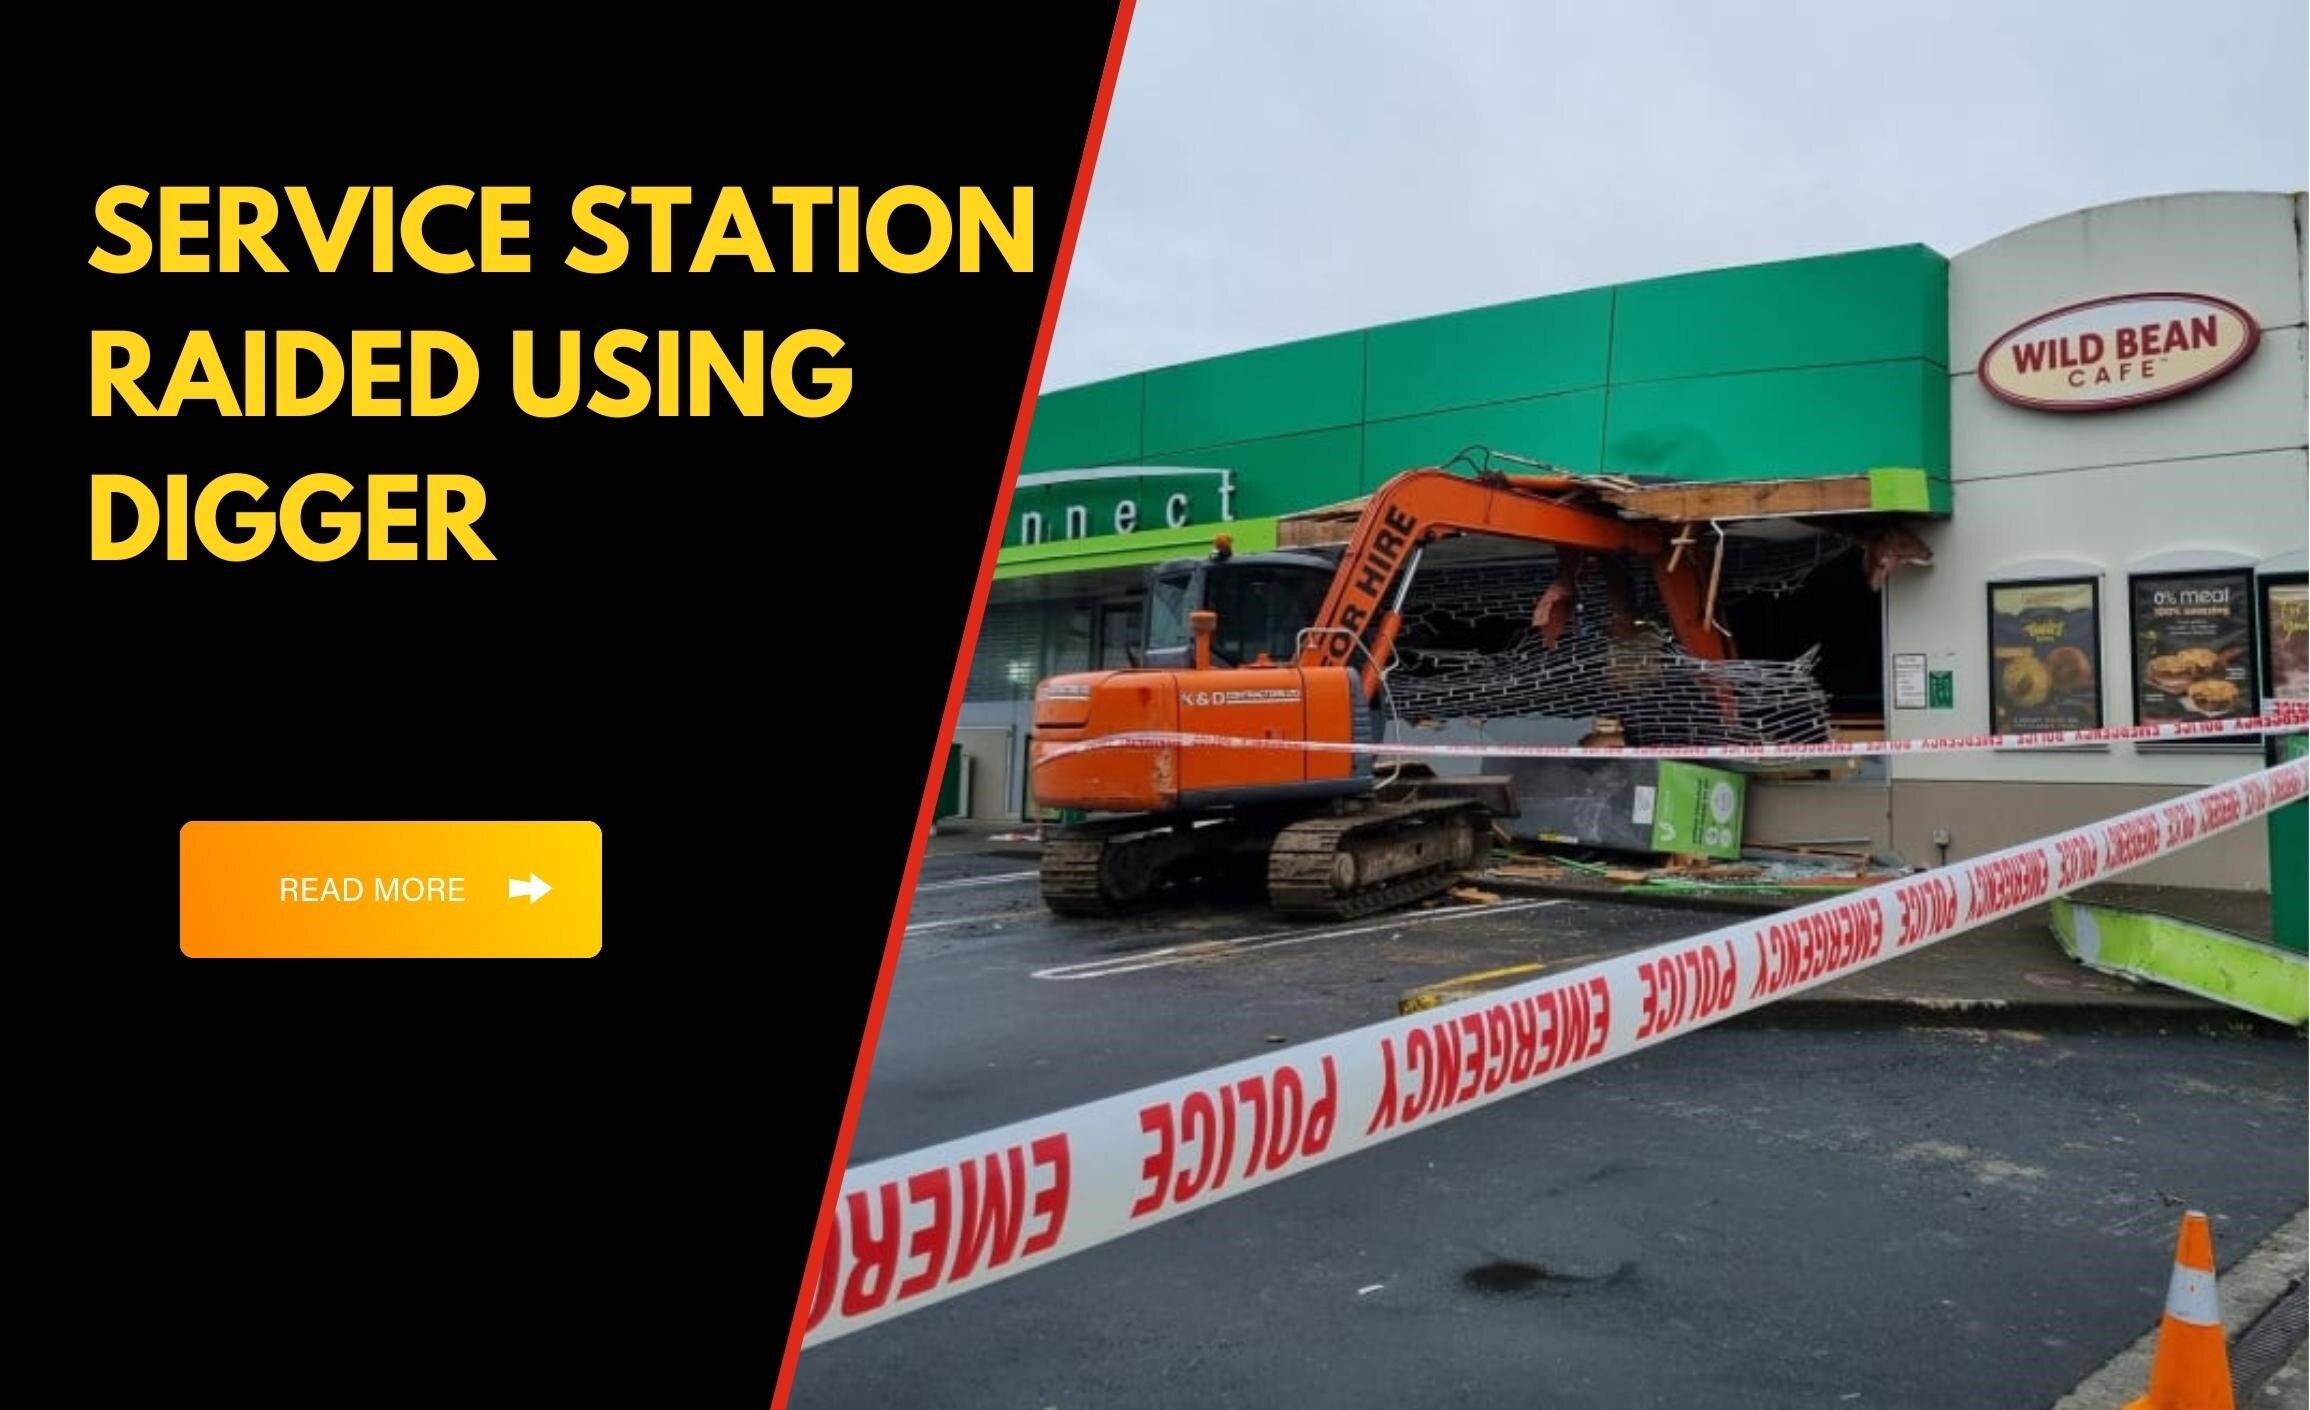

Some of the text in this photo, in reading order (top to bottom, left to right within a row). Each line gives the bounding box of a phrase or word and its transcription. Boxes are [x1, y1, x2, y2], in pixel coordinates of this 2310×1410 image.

[2012, 314, 2218, 373] WILD BEAN
[2068, 361, 2155, 387] CAFE
[1354, 504, 1418, 598] HIRE
[1181, 692, 1195, 706] K
[1196, 692, 1210, 706] &
[2055, 834, 2099, 890] POLICE
[2104, 813, 2161, 871] EMERGENCY
[1895, 875, 1959, 948] POLICE
[1966, 847, 2050, 922] EMERGENCY
[1752, 896, 1885, 1000] EMERGENCY
[1636, 939, 1740, 1041] POLICE
[1366, 976, 1612, 1136] EMERGENCY
[1130, 1055, 1340, 1219] POLICE
